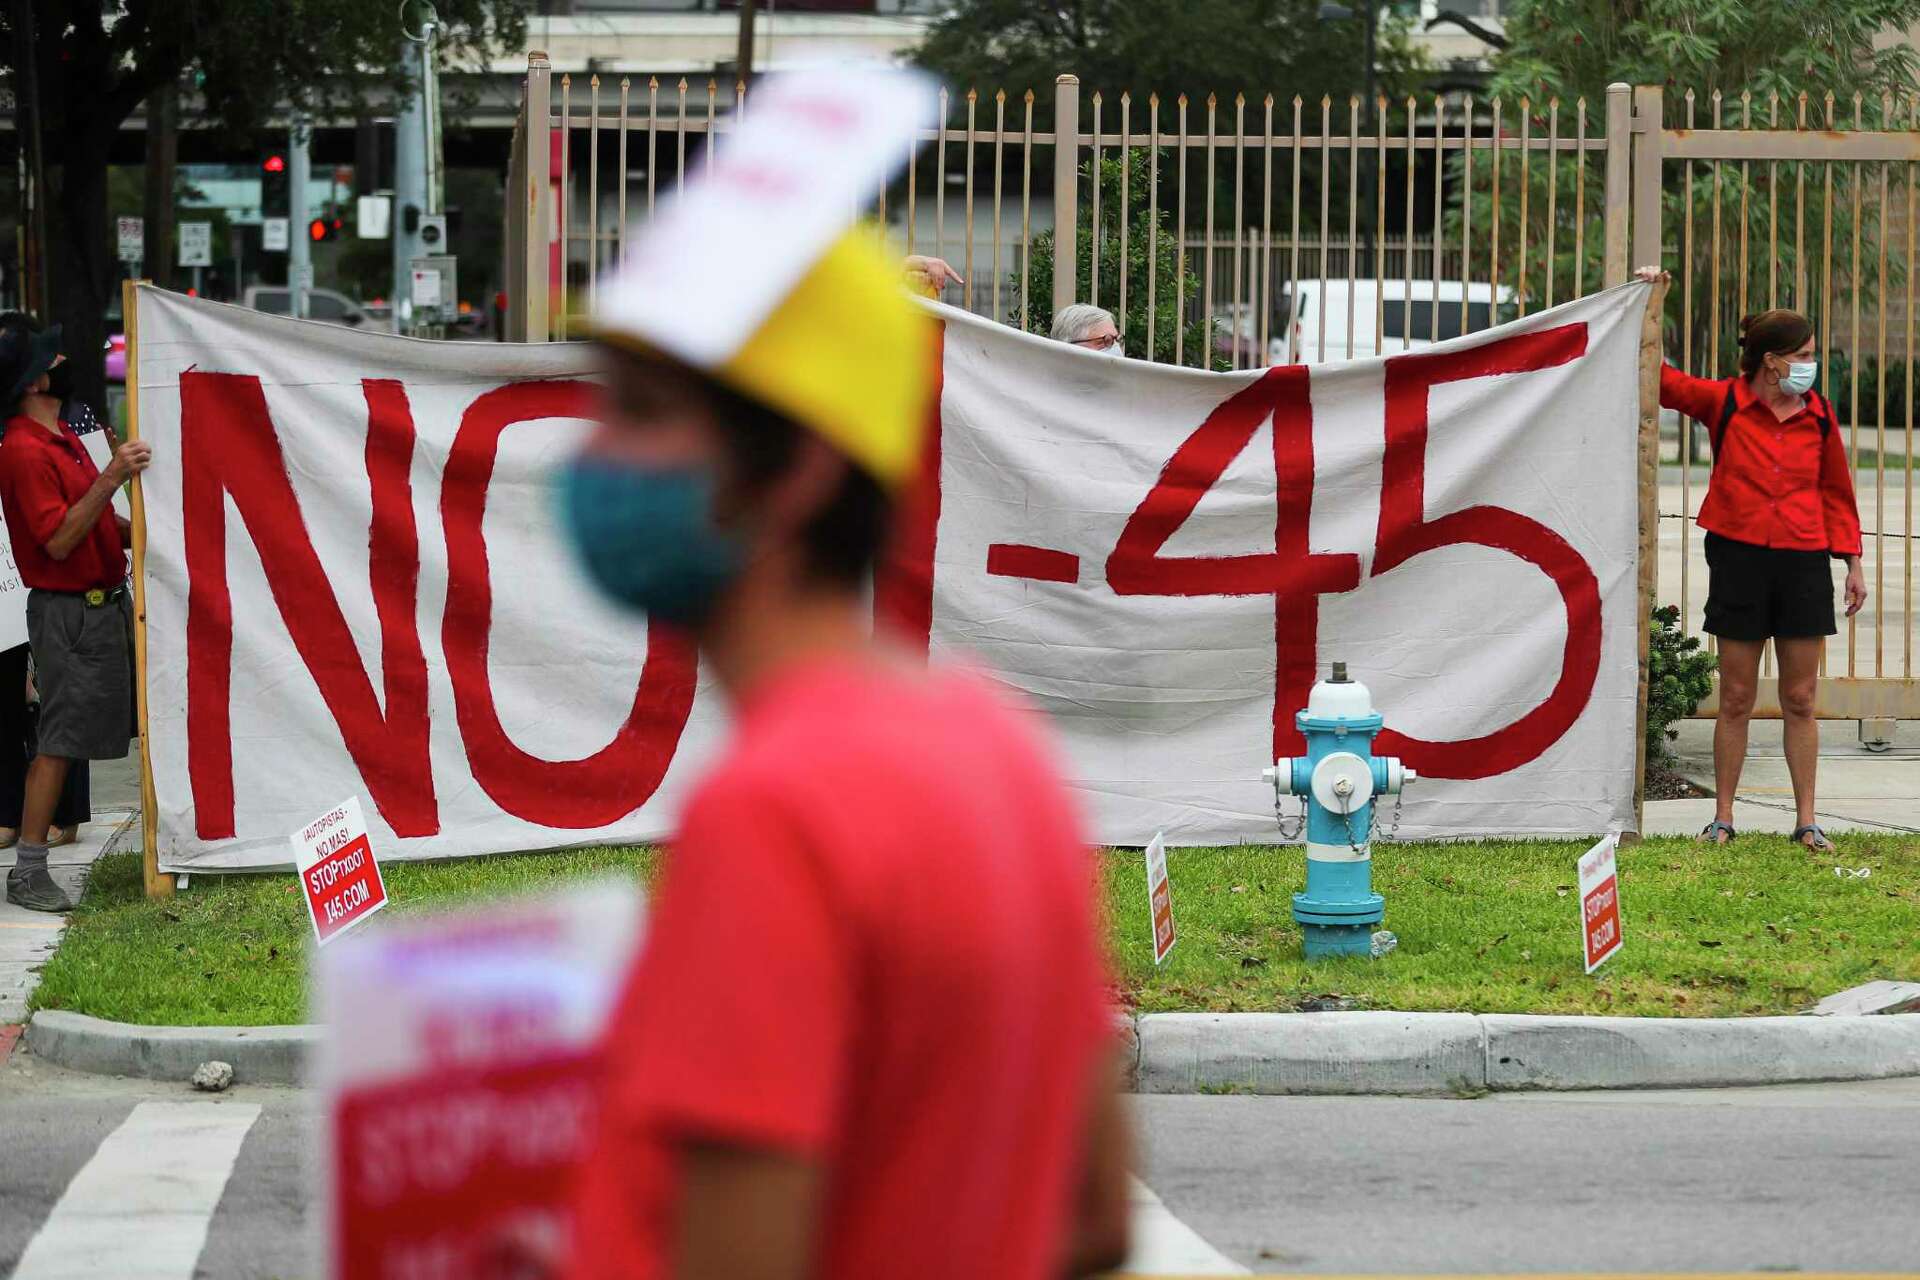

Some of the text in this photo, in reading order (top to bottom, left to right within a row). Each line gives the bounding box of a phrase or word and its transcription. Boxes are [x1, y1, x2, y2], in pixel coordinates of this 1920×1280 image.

[179, 366, 700, 840] NO
[316, 843, 329, 859] NO
[324, 878, 371, 925] I45.COM
